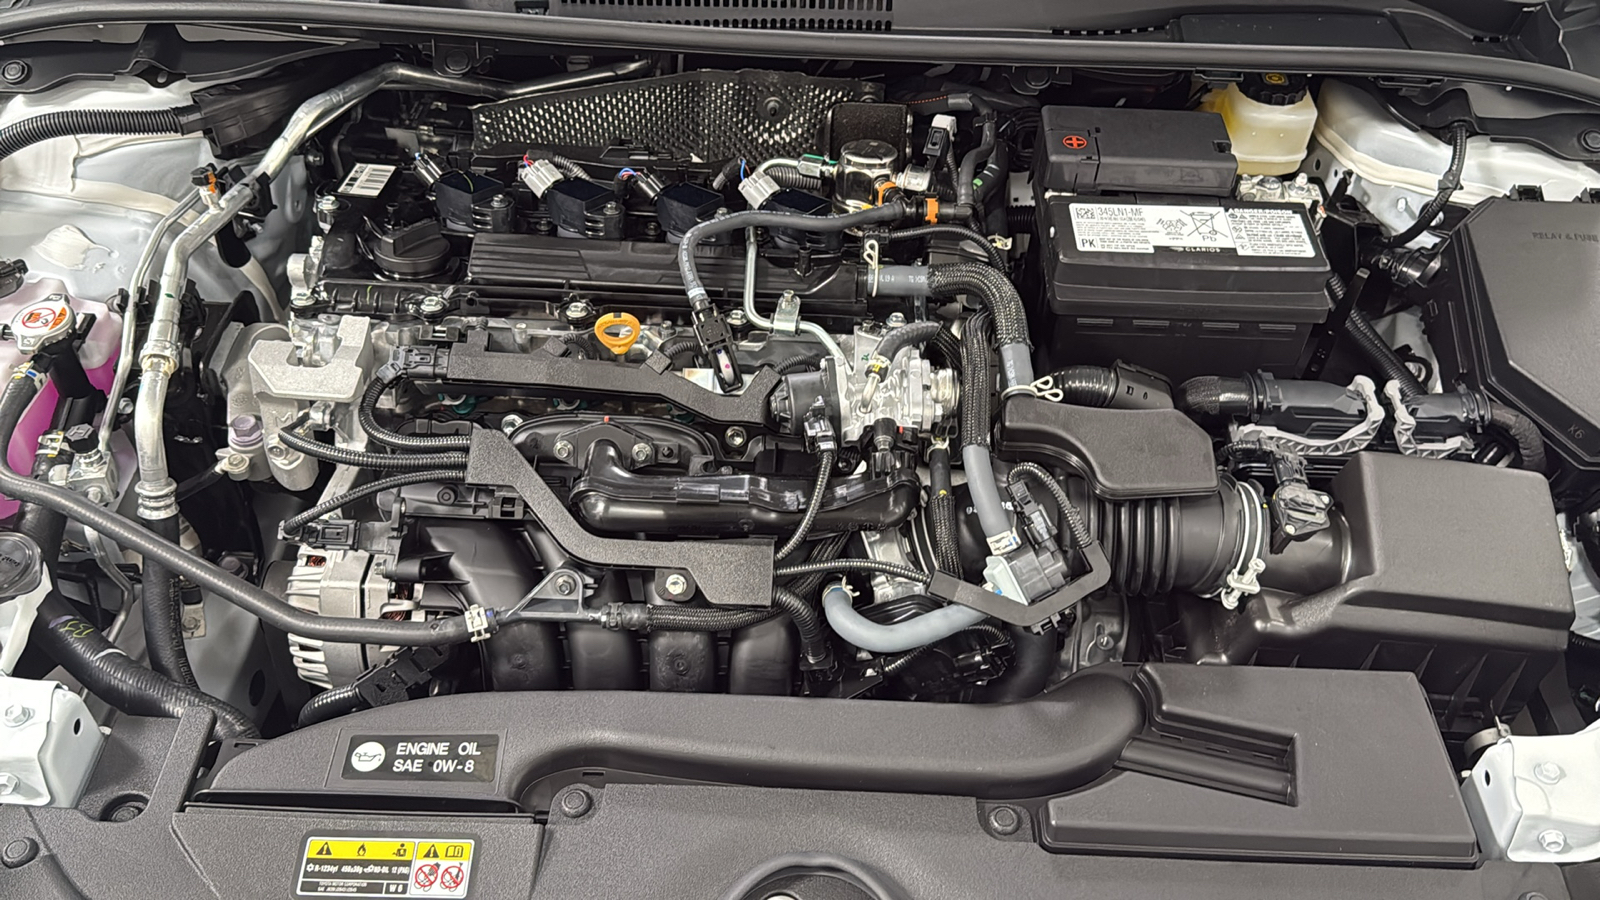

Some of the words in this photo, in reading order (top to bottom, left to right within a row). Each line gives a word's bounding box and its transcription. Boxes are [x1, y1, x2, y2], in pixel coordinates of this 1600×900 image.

[1081, 238, 1096, 248] PK
[1202, 234, 1217, 242] Pb
[395, 742, 450, 756] ENGINE
[457, 742, 481, 756] OIL
[392, 759, 424, 773] SAE
[432, 759, 475, 773] 0W-8
[389, 884, 397, 892] W
